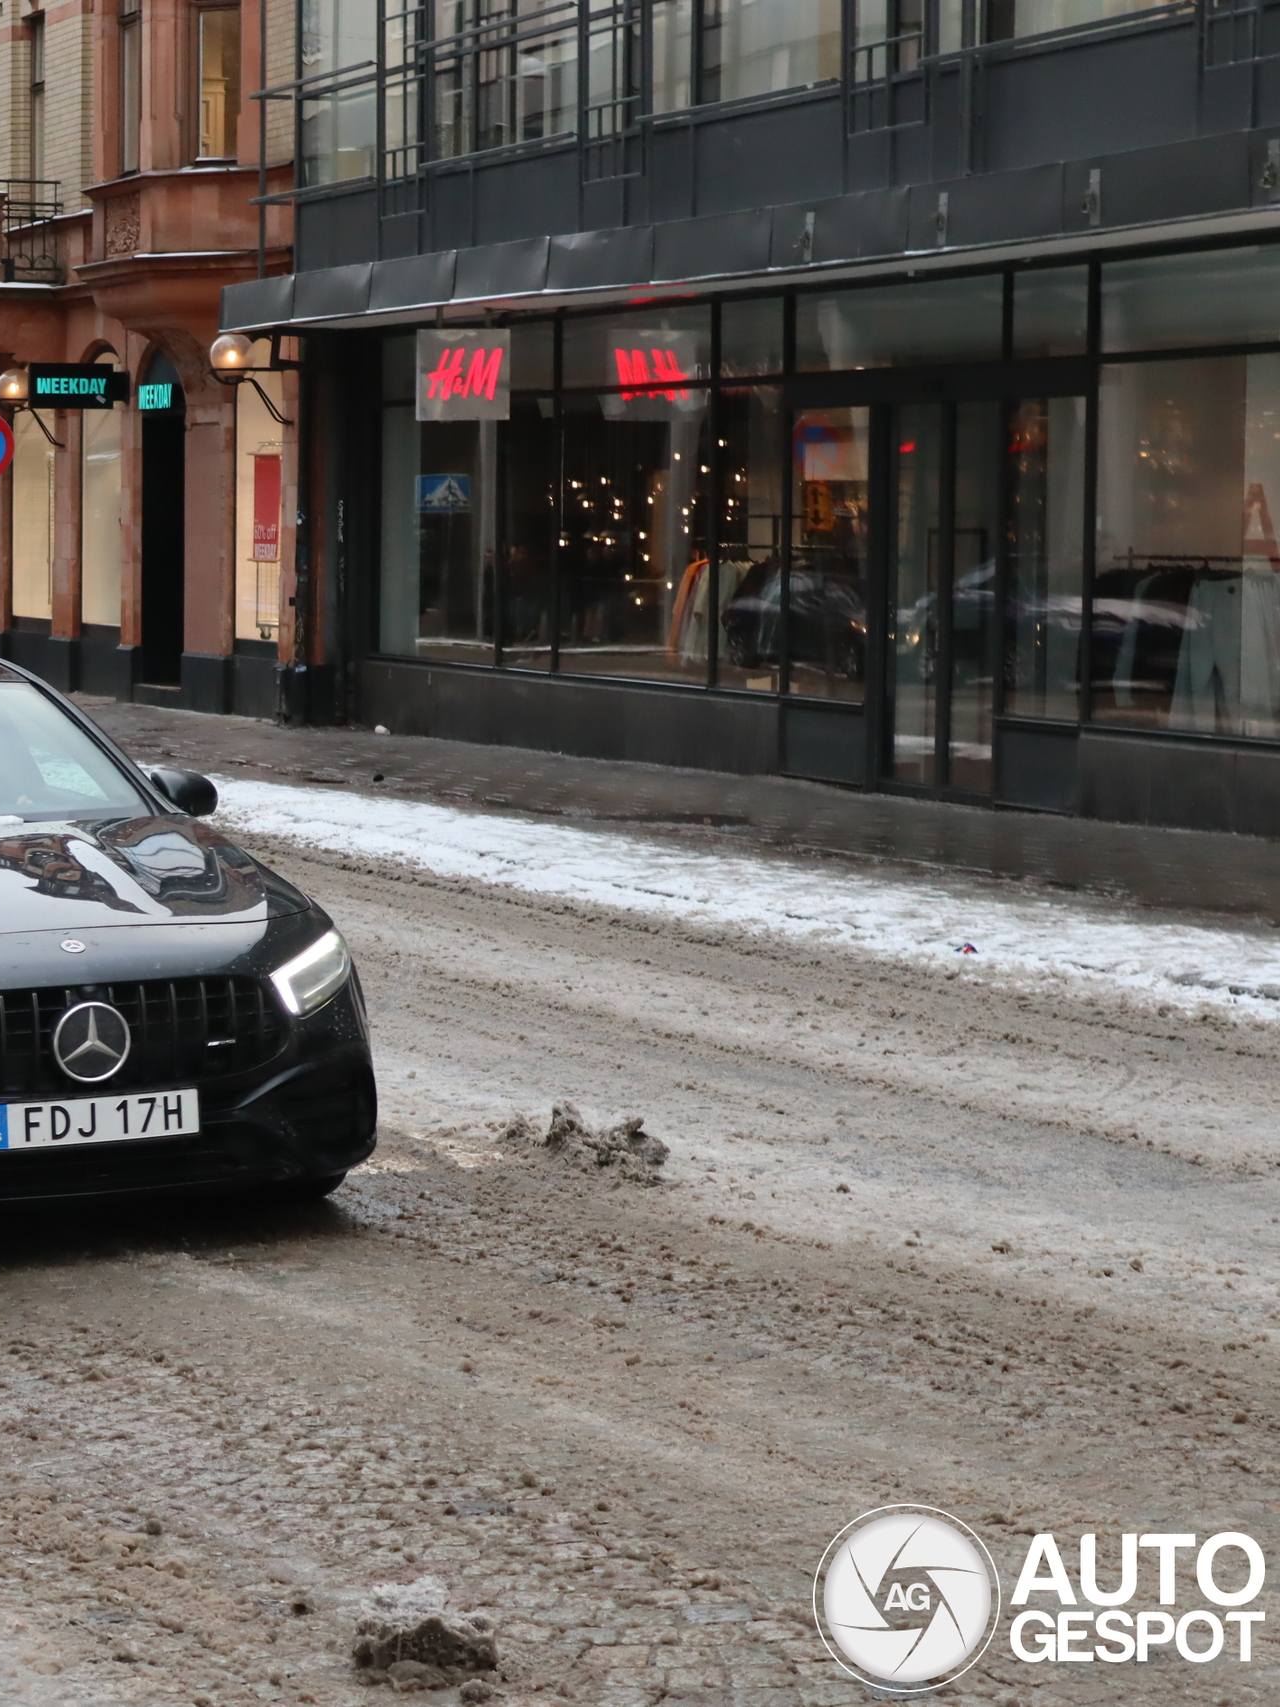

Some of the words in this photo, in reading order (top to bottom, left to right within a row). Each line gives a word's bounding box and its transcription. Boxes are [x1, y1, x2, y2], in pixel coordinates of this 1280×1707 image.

[36, 377, 107, 394] WEEKDAY
[427, 348, 503, 401] H&M
[138, 383, 172, 410] WEEKDAY
[267, 524, 277, 540] off
[24, 1102, 96, 1142] FDJ
[115, 1094, 183, 1135] 17H
